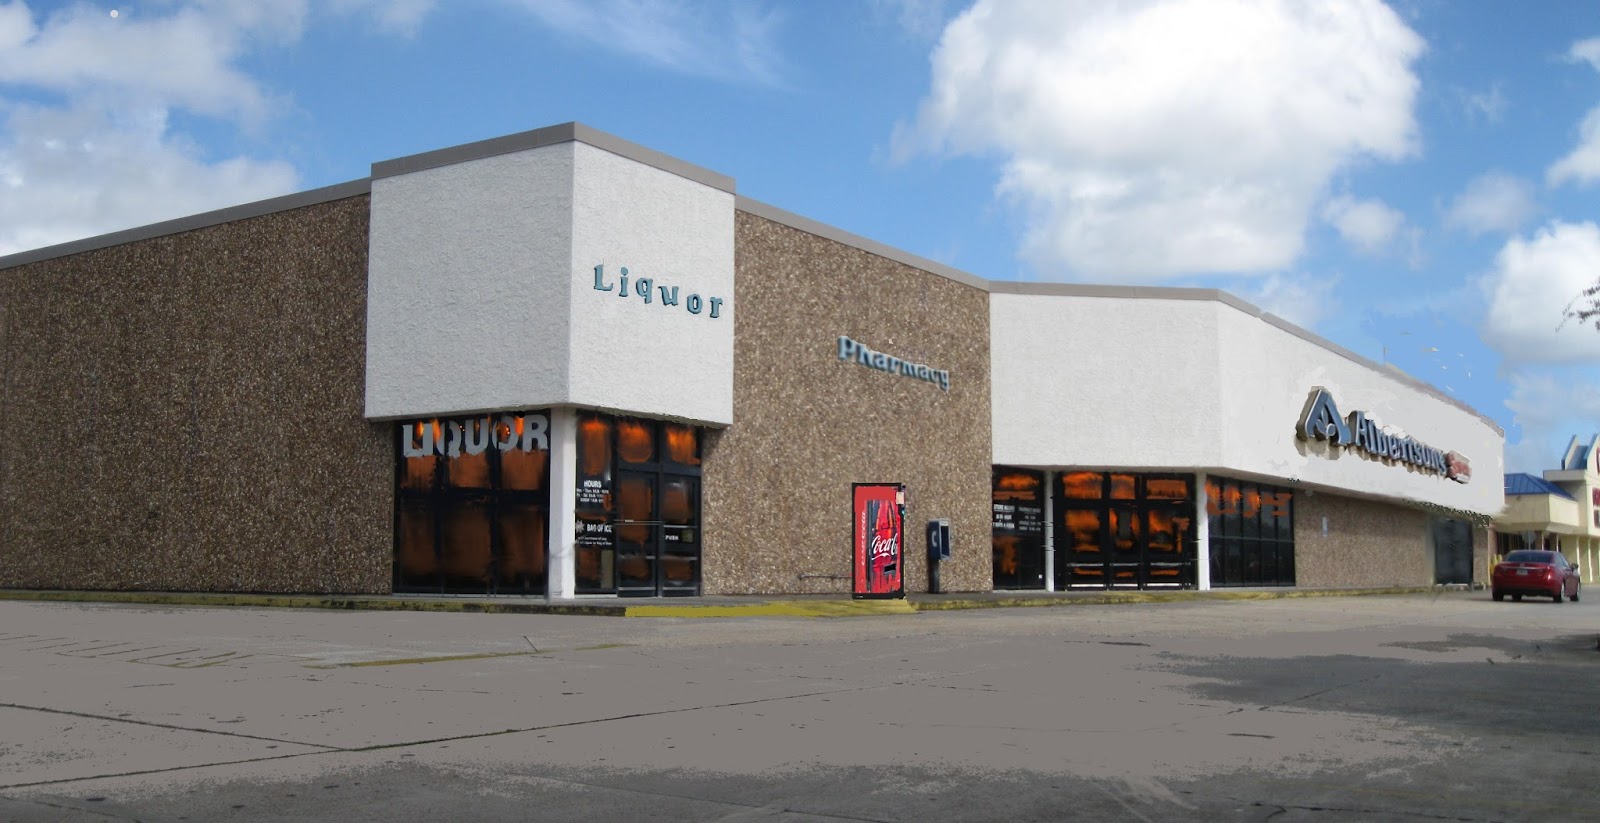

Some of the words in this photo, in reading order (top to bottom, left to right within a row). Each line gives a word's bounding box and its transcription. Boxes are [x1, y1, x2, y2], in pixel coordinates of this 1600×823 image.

[593, 264, 723, 318] Liquor
[837, 335, 949, 393] Pharmacy
[402, 414, 549, 459] LIQUOR
[1351, 410, 1447, 476] Albertsons
[583, 480, 602, 488] HOURS
[587, 524, 596, 532] BAG
[597, 524, 604, 532] OF
[604, 525, 612, 533] ICE
